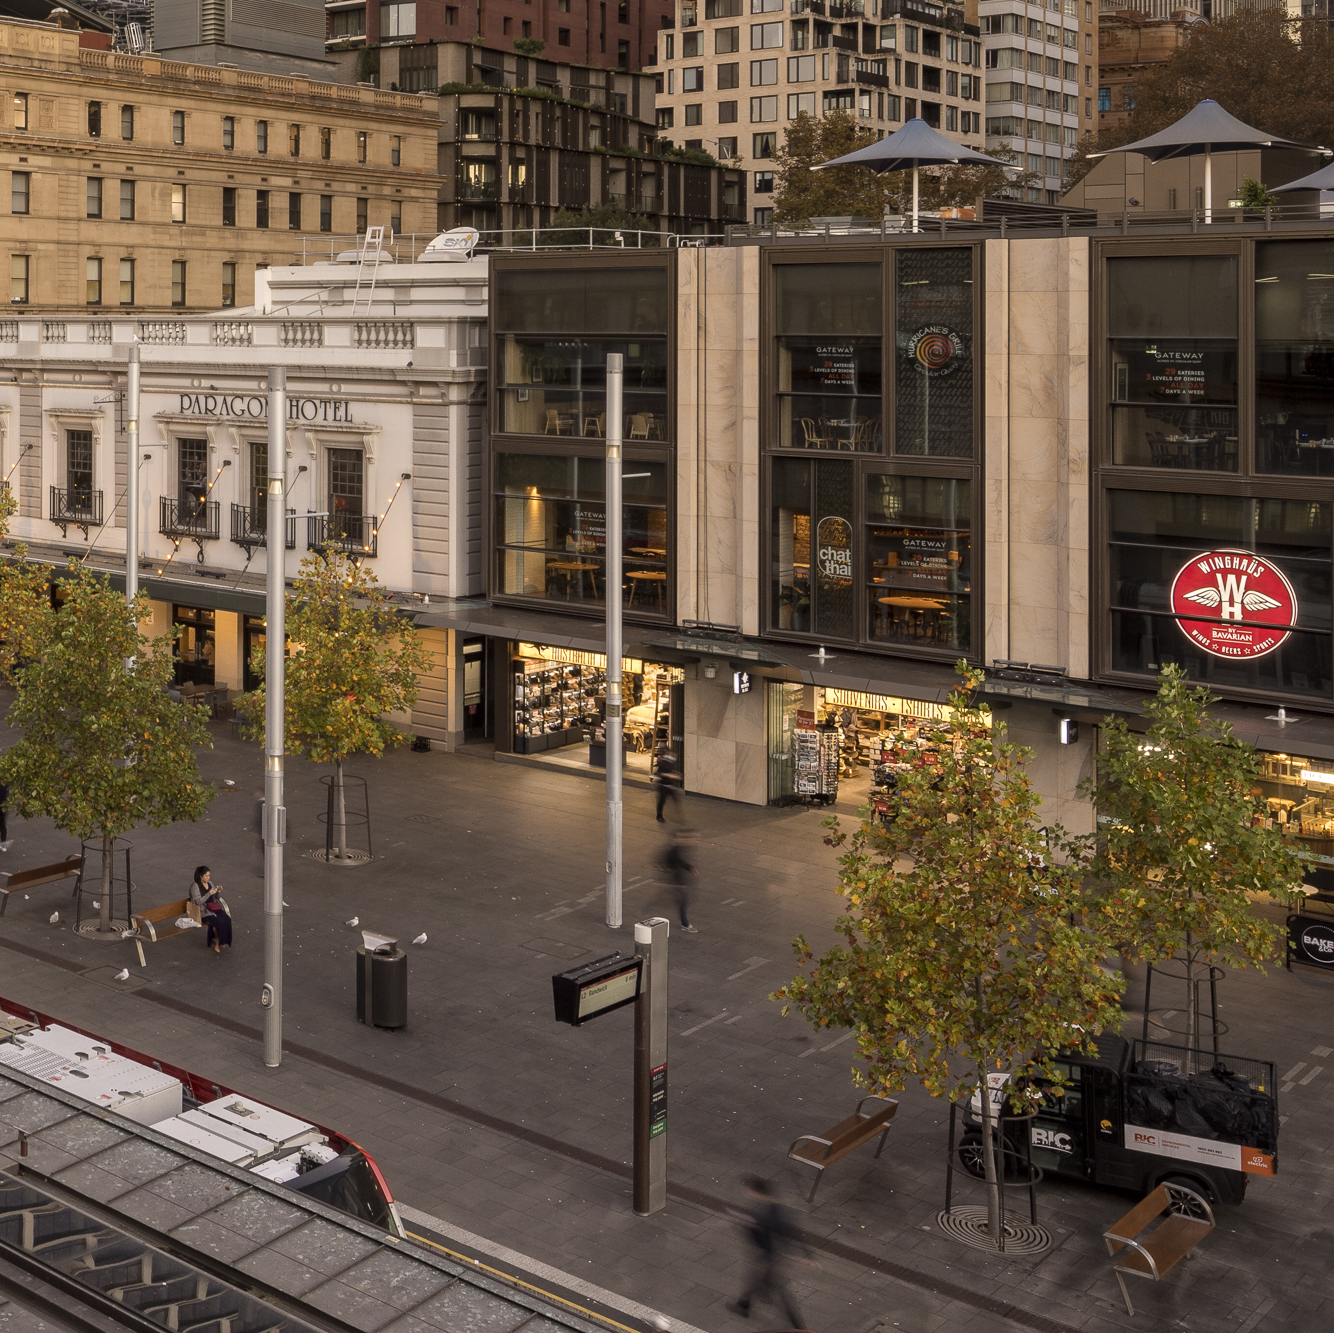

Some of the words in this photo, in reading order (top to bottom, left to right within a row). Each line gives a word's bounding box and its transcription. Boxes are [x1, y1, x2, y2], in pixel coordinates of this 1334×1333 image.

[907, 326, 949, 358] HURRICANE'S
[179, 394, 268, 418] PARAGO
[288, 399, 353, 423] HOTEL
[902, 538, 946, 548] GATEWAY
[819, 546, 851, 563] chat
[825, 560, 852, 576] thai
[1197, 556, 1265, 578] WINGHAÜS
[1191, 629, 1211, 646] WINGS
[1252, 637, 1275, 653] SPORTS
[1212, 631, 1253, 642] BAVARIAN
[833, 688, 889, 711] SOUVENIRS
[589, 984, 608, 997] Randwick
[1247, 1160, 1268, 1169] electric
